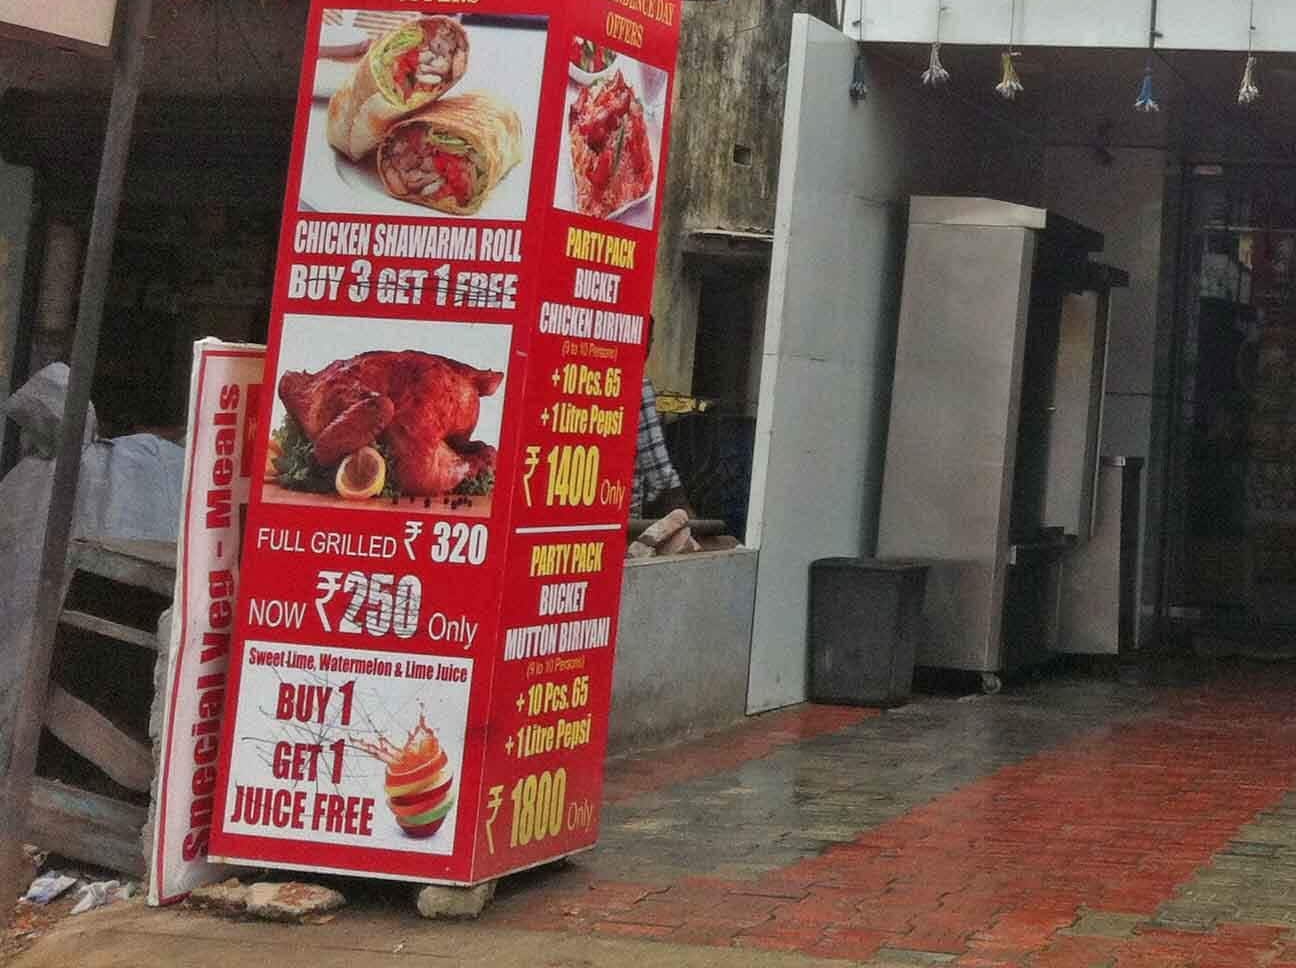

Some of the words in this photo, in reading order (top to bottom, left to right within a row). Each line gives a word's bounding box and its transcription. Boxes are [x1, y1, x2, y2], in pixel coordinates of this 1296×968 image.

[605, 12, 644, 48] OFFERS
[294, 219, 371, 257] CHICKEN
[374, 222, 477, 261] SHAWARMA
[480, 226, 522, 263] ROLL
[566, 226, 605, 264] PARTY
[605, 233, 637, 270] PACK
[288, 264, 345, 301] BUY
[347, 260, 373, 303] 3
[376, 268, 429, 306] GET
[431, 263, 451, 307] 1
[453, 272, 518, 310] FREE
[574, 267, 621, 304] BUCKET
[539, 301, 594, 339] CHICKEN
[593, 310, 644, 344] BIRIYANI
[604, 367, 622, 398] 65
[559, 403, 588, 435] Litre
[589, 403, 625, 438] Pepsi
[205, 383, 240, 529] Meals
[600, 478, 626, 511] Only
[256, 527, 305, 553] FULL
[311, 531, 398, 560] GRILLED
[530, 544, 573, 577] PARTY
[572, 542, 604, 573] PACK
[538, 582, 588, 617] BUCKET
[248, 598, 308, 630] NOW
[428, 612, 479, 651] Only
[504, 624, 558, 662] MUTTON
[559, 617, 611, 654] BIRIYANI
[249, 647, 285, 667] Sweet
[319, 653, 391, 677] Watermelon
[406, 660, 434, 681] Lime
[436, 663, 468, 683] Juice
[276, 682, 333, 723] BUY
[338, 680, 356, 726] 1
[572, 675, 589, 709] 65
[525, 722, 555, 758] Litre
[556, 713, 593, 752] Pepsi
[272, 741, 325, 783] GET
[329, 738, 346, 784] 1
[230, 785, 311, 826] JUICE
[313, 794, 376, 837] FREE
[567, 800, 594, 832] Only
